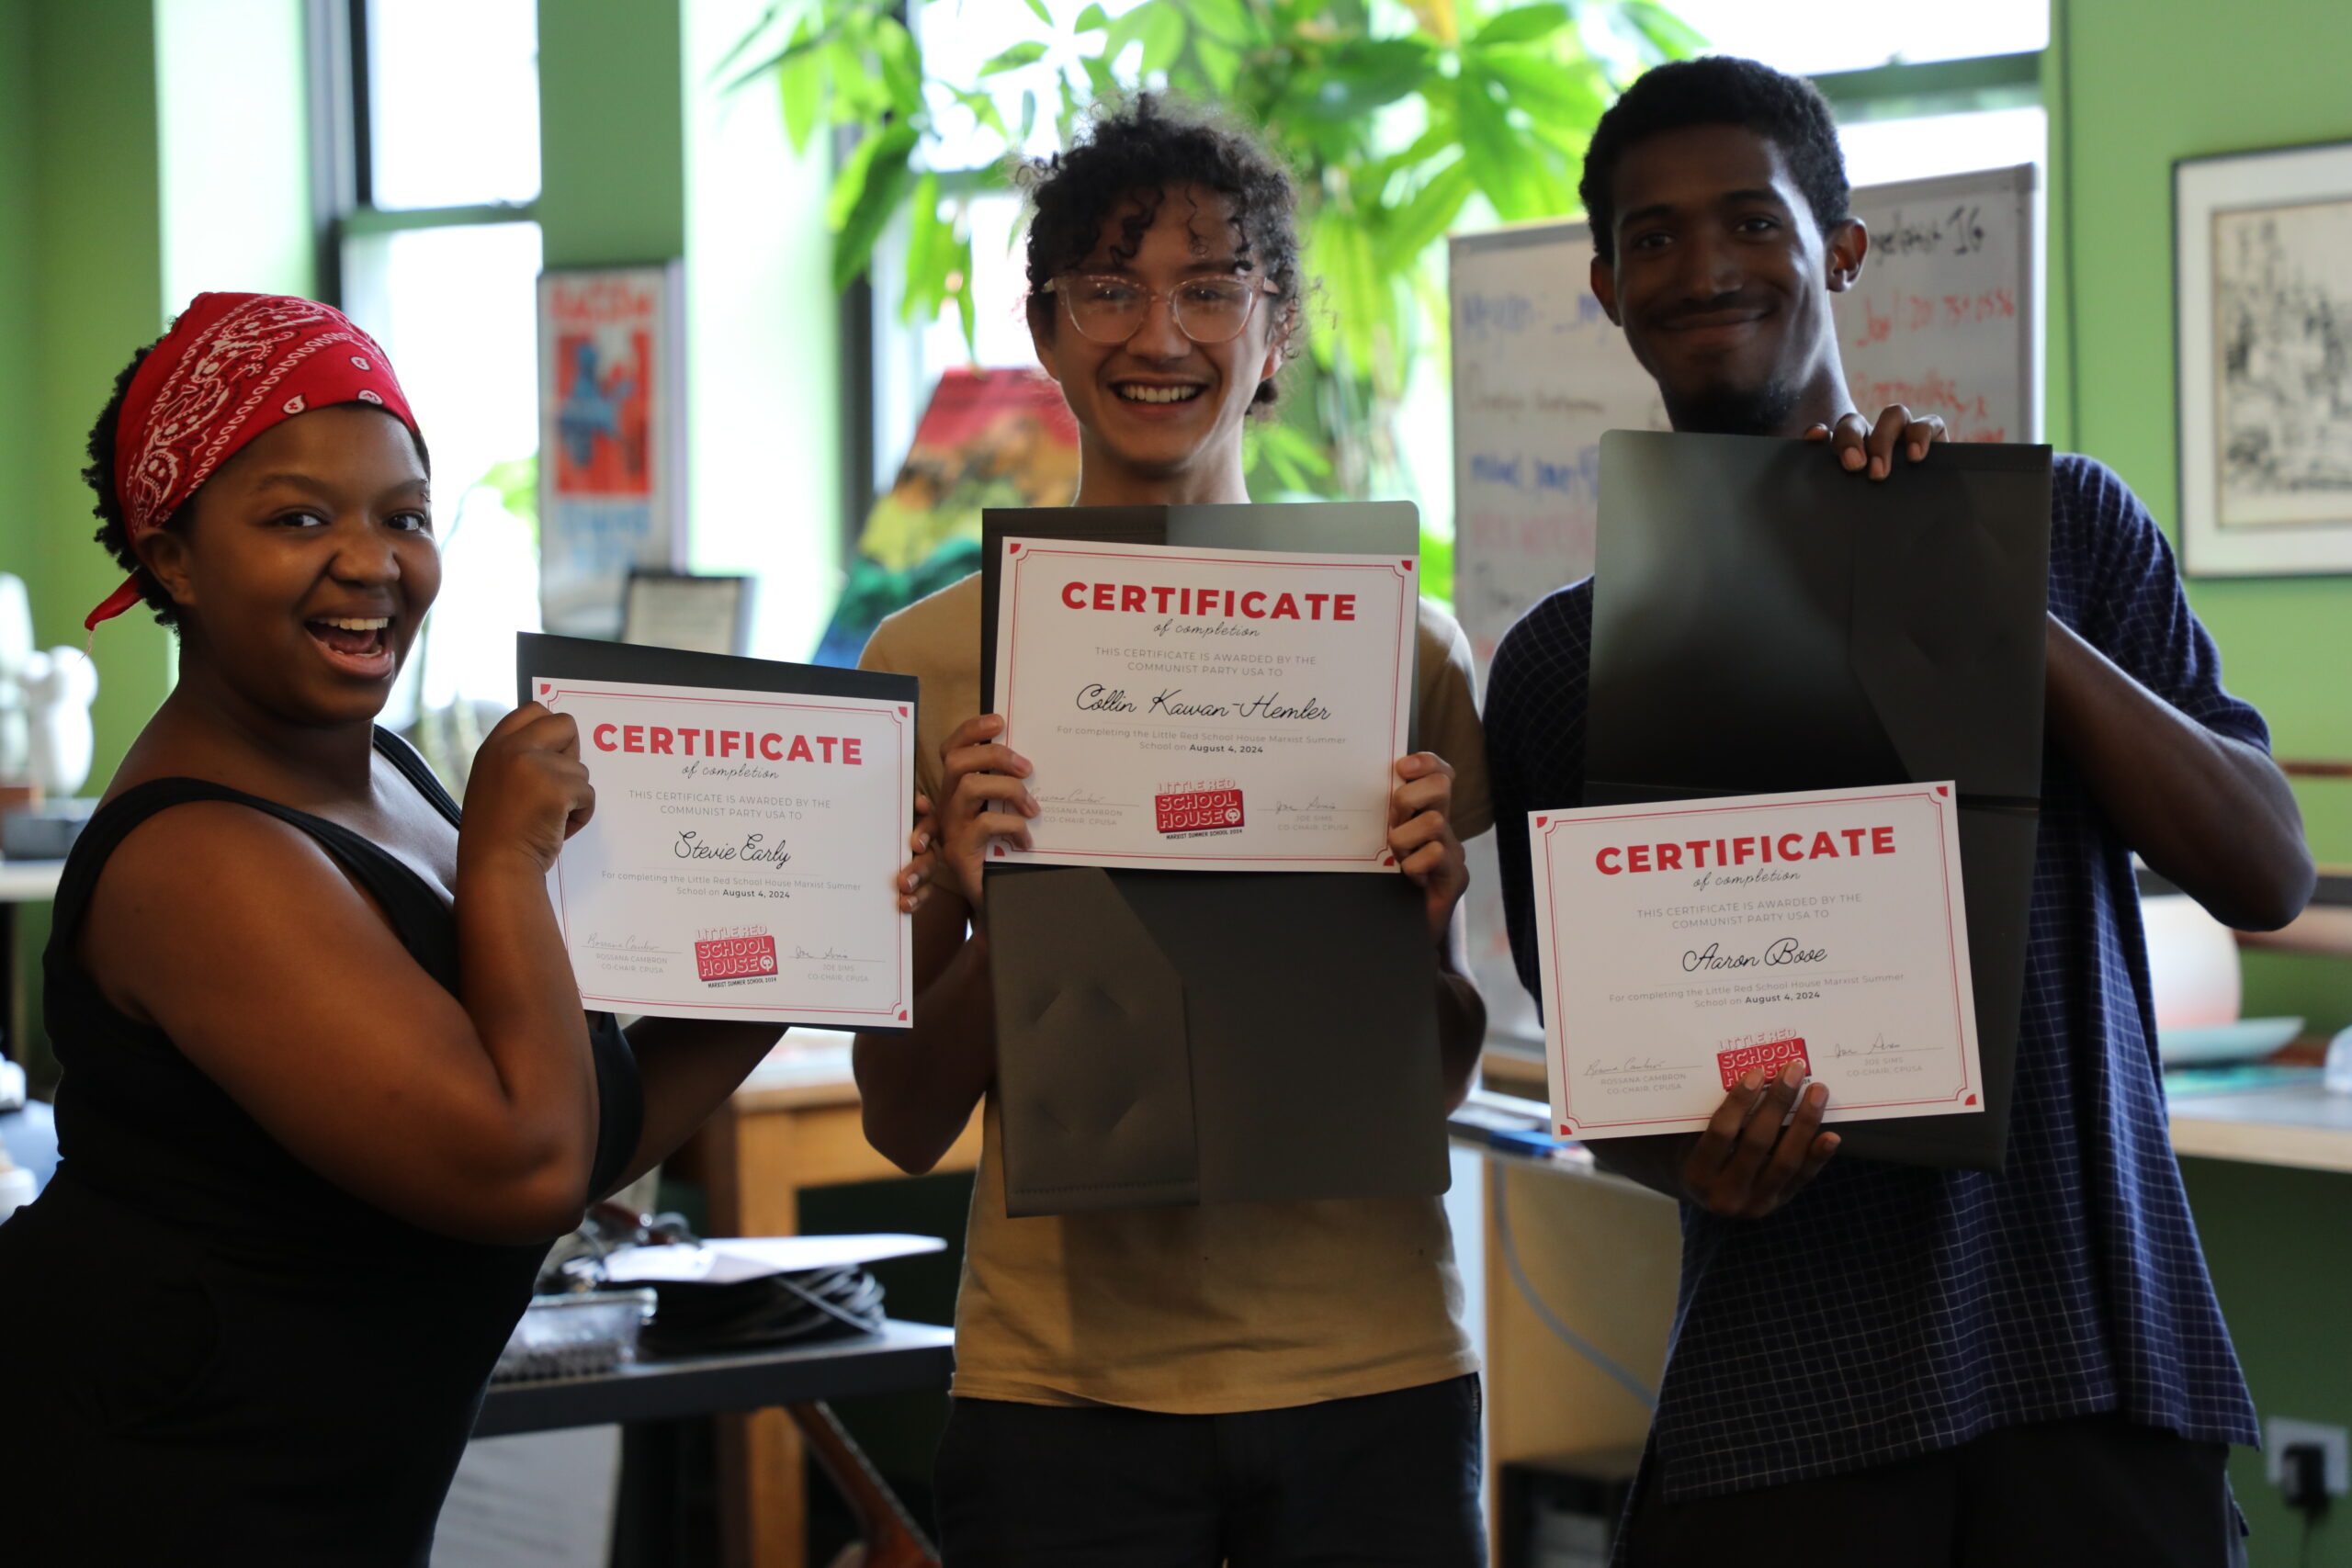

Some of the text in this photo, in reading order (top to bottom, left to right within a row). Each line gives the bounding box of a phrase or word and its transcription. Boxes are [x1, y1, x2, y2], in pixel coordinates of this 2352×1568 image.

[1061, 581, 1356, 621] CERTIFICATE
[1153, 619, 1261, 638] of completion
[1095, 647, 1317, 665] THIS CERTIFICATE IS AWARDED BY THE
[1127, 661, 1283, 677] COMMUNIST PARTY USA TO
[1076, 683, 1332, 721] Collin Kawan-Hemler
[593, 723, 863, 765] CERTIFICATE
[1057, 726, 1346, 744] For completing the Little Red School House Marxist Summer
[1138, 741, 1171, 750] School
[1189, 744, 1225, 753] August
[1227, 745, 1237, 754] 4,
[1239, 745, 1264, 753] 2024
[681, 761, 780, 781] of completion
[1158, 778, 1236, 795] LITTLE RED
[628, 790, 831, 809] THIS CERTIFICATE IS AWARDED BY THE
[1158, 791, 1238, 812] SCHOOL
[660, 805, 802, 820] COMMUNIST PARTY USA TO
[1080, 808, 1123, 817] CAMBRON
[1159, 808, 1225, 829] HOUSE
[674, 830, 791, 870] Stevie Early
[1596, 826, 1895, 875] CERTIFICATE
[602, 870, 861, 891] For completing the Little Red School House Marxist Summer
[1693, 867, 1801, 892] of completion
[676, 886, 706, 896] School
[722, 889, 755, 898] August
[758, 890, 766, 899] 4,
[768, 890, 790, 899] 2024
[1637, 893, 1862, 919] THIS CERTIFICATE IS AWARDED BY THE
[1671, 909, 1829, 930] COMMUNIST PARTY USA TO
[697, 924, 768, 942] LITTLE RED
[698, 938, 770, 959] SCHOOL
[1682, 942, 1760, 972] Aaron
[596, 953, 668, 964] ROSSANA CAMBRON
[698, 955, 760, 977] HOUSE
[639, 965, 663, 974] CPUSA
[845, 975, 869, 983] CPUSA
[707, 981, 727, 989] MARXIST
[728, 979, 746, 987] SUMMER
[1609, 974, 1905, 1002] For completing the Little Red School House Marxist Summer
[1693, 998, 1727, 1008] School
[1745, 994, 1781, 1005] August
[1783, 993, 1793, 1001] 4,
[1796, 990, 1821, 1000] 2024
[1719, 1028, 1797, 1052] LITTLE RED
[1721, 1041, 1802, 1069] SCHOOL
[1883, 1056, 1905, 1065] SIMS
[1600, 1073, 1687, 1086] ROSSANA CAMBRON
[1894, 1066, 1924, 1074] CPUSA
[1653, 1083, 1683, 1091] CPUSA
